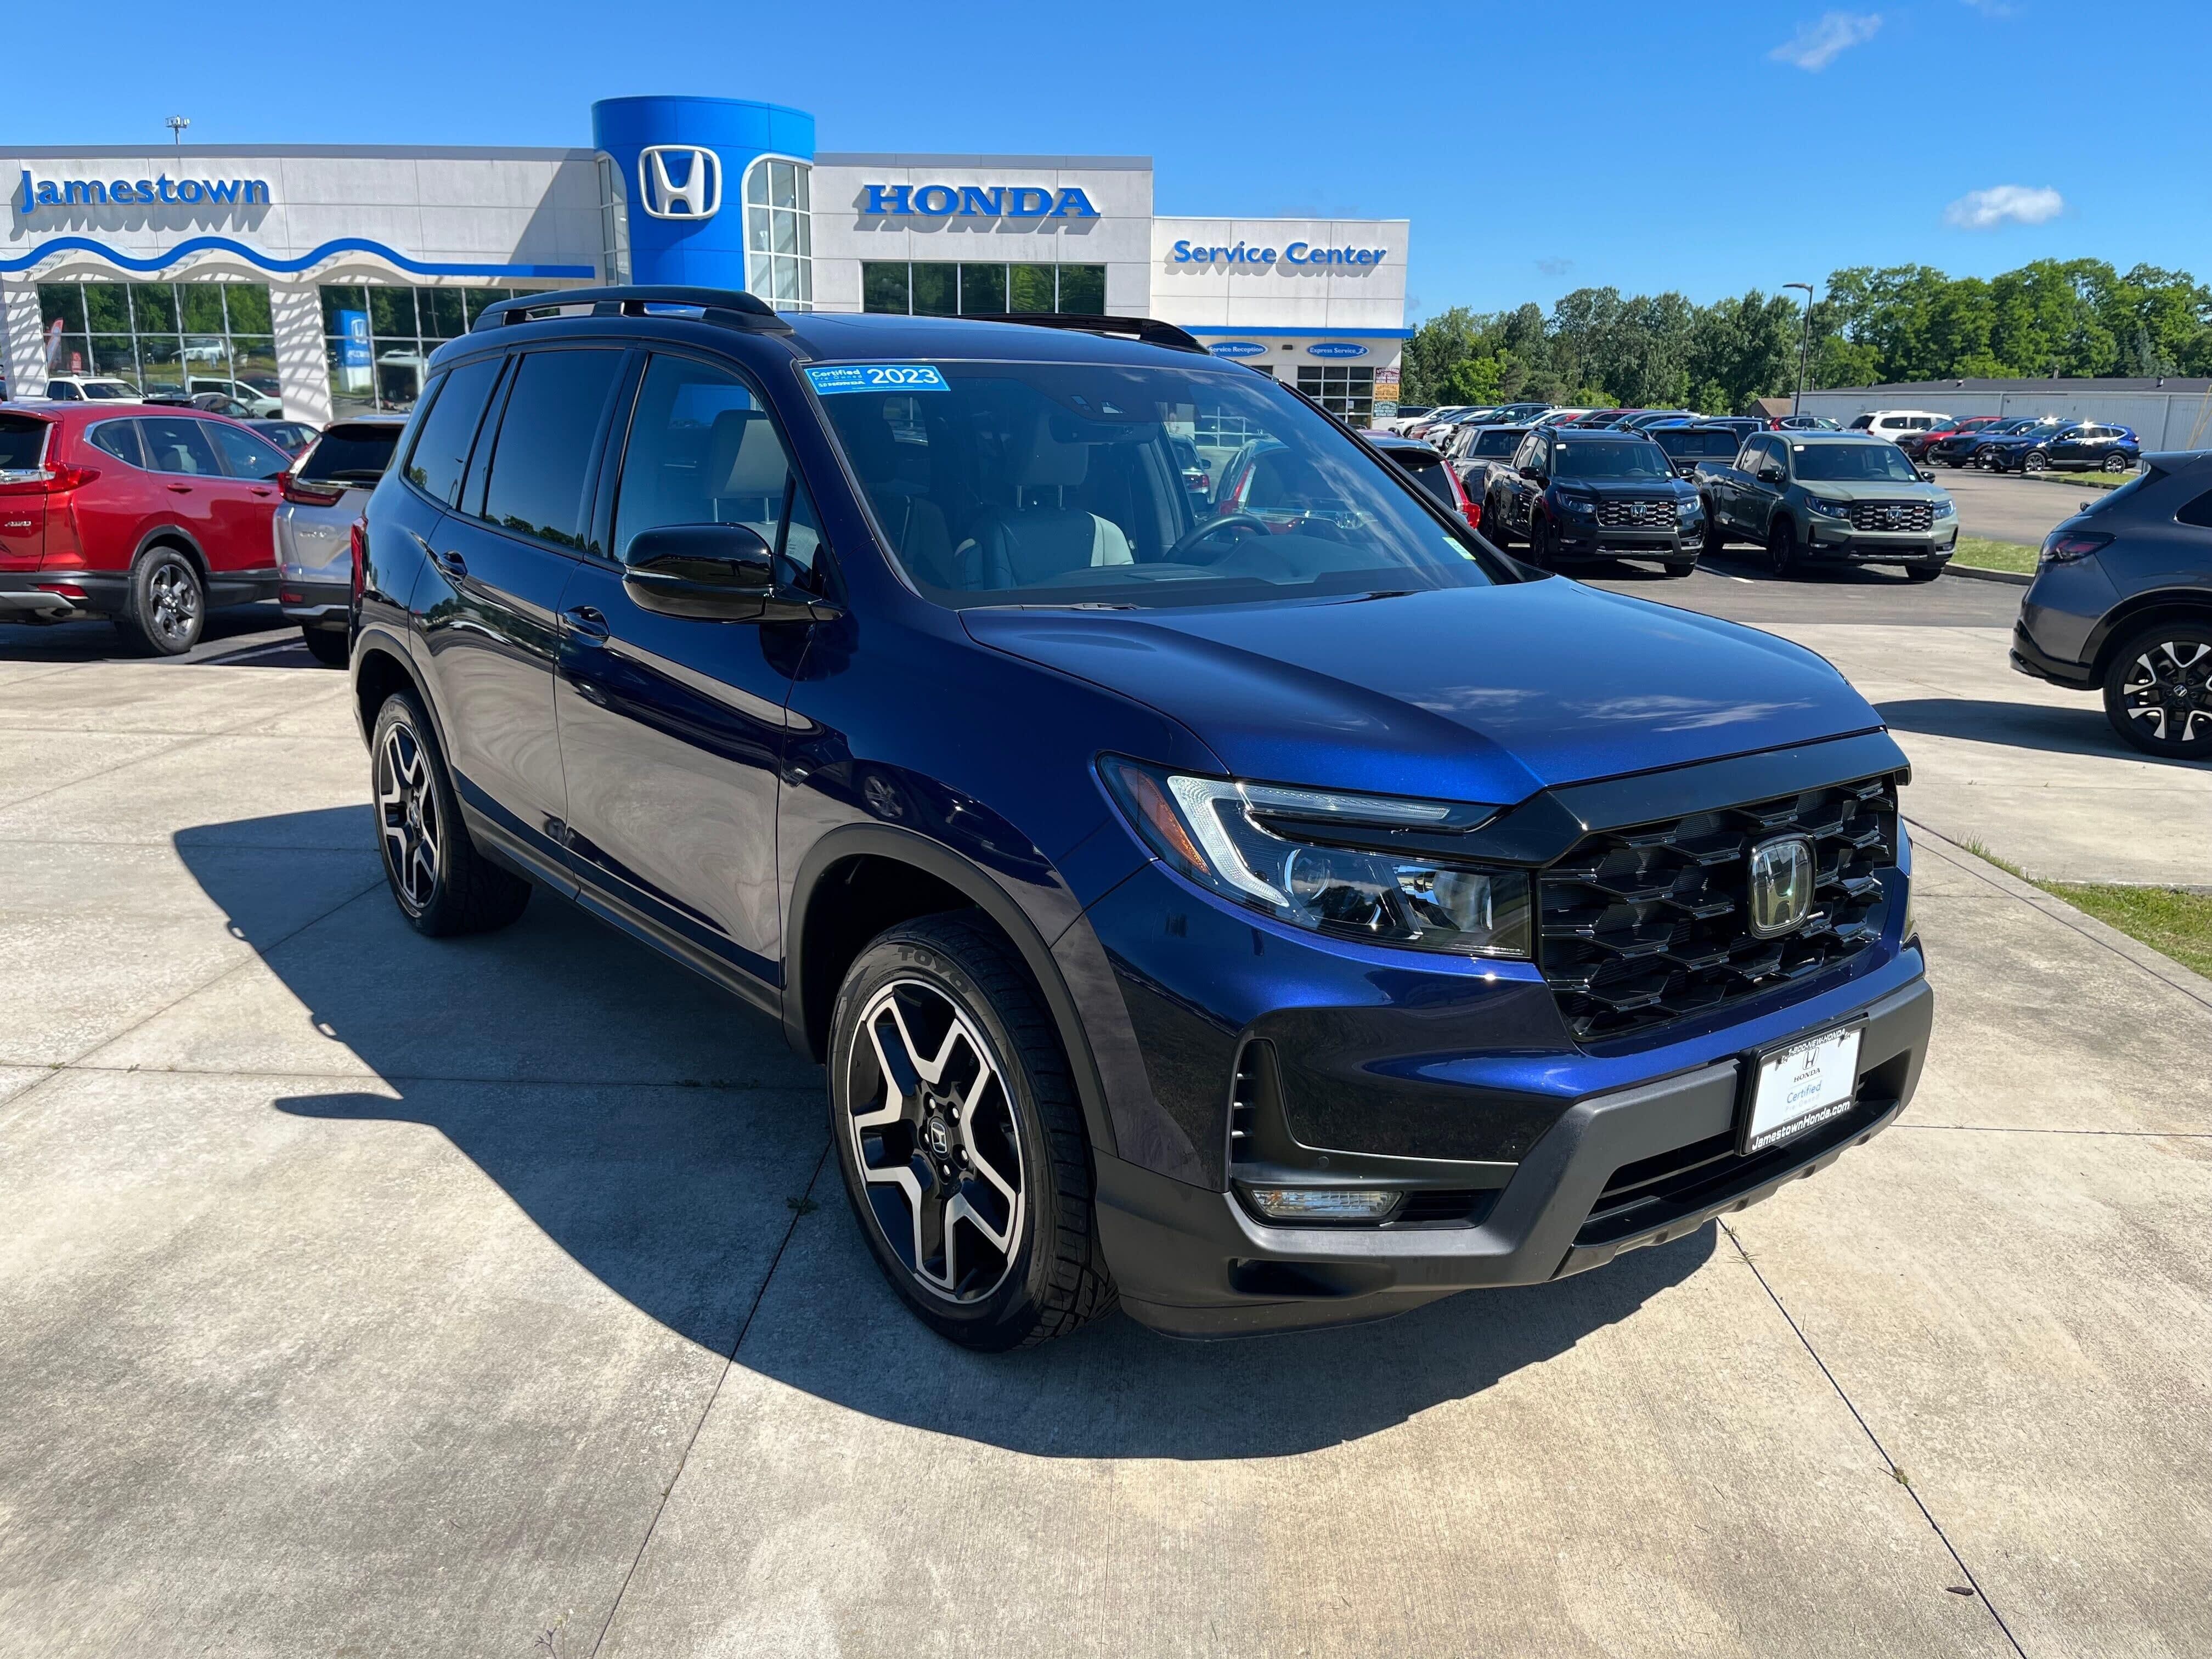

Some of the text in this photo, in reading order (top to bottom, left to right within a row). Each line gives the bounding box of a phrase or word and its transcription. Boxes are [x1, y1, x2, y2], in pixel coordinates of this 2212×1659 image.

[20, 170, 270, 215] Jamestown
[864, 184, 1101, 218] HONDA
[1174, 240, 1387, 266] Service Center
[811, 369, 861, 377] Certified
[867, 368, 939, 384] 2023
[897, 946, 969, 993] TOYO
[1793, 1068, 1821, 1083] HONDA
[1786, 1080, 1822, 1104] Certified
[1752, 1101, 1851, 1150] JamestownHonda.com
